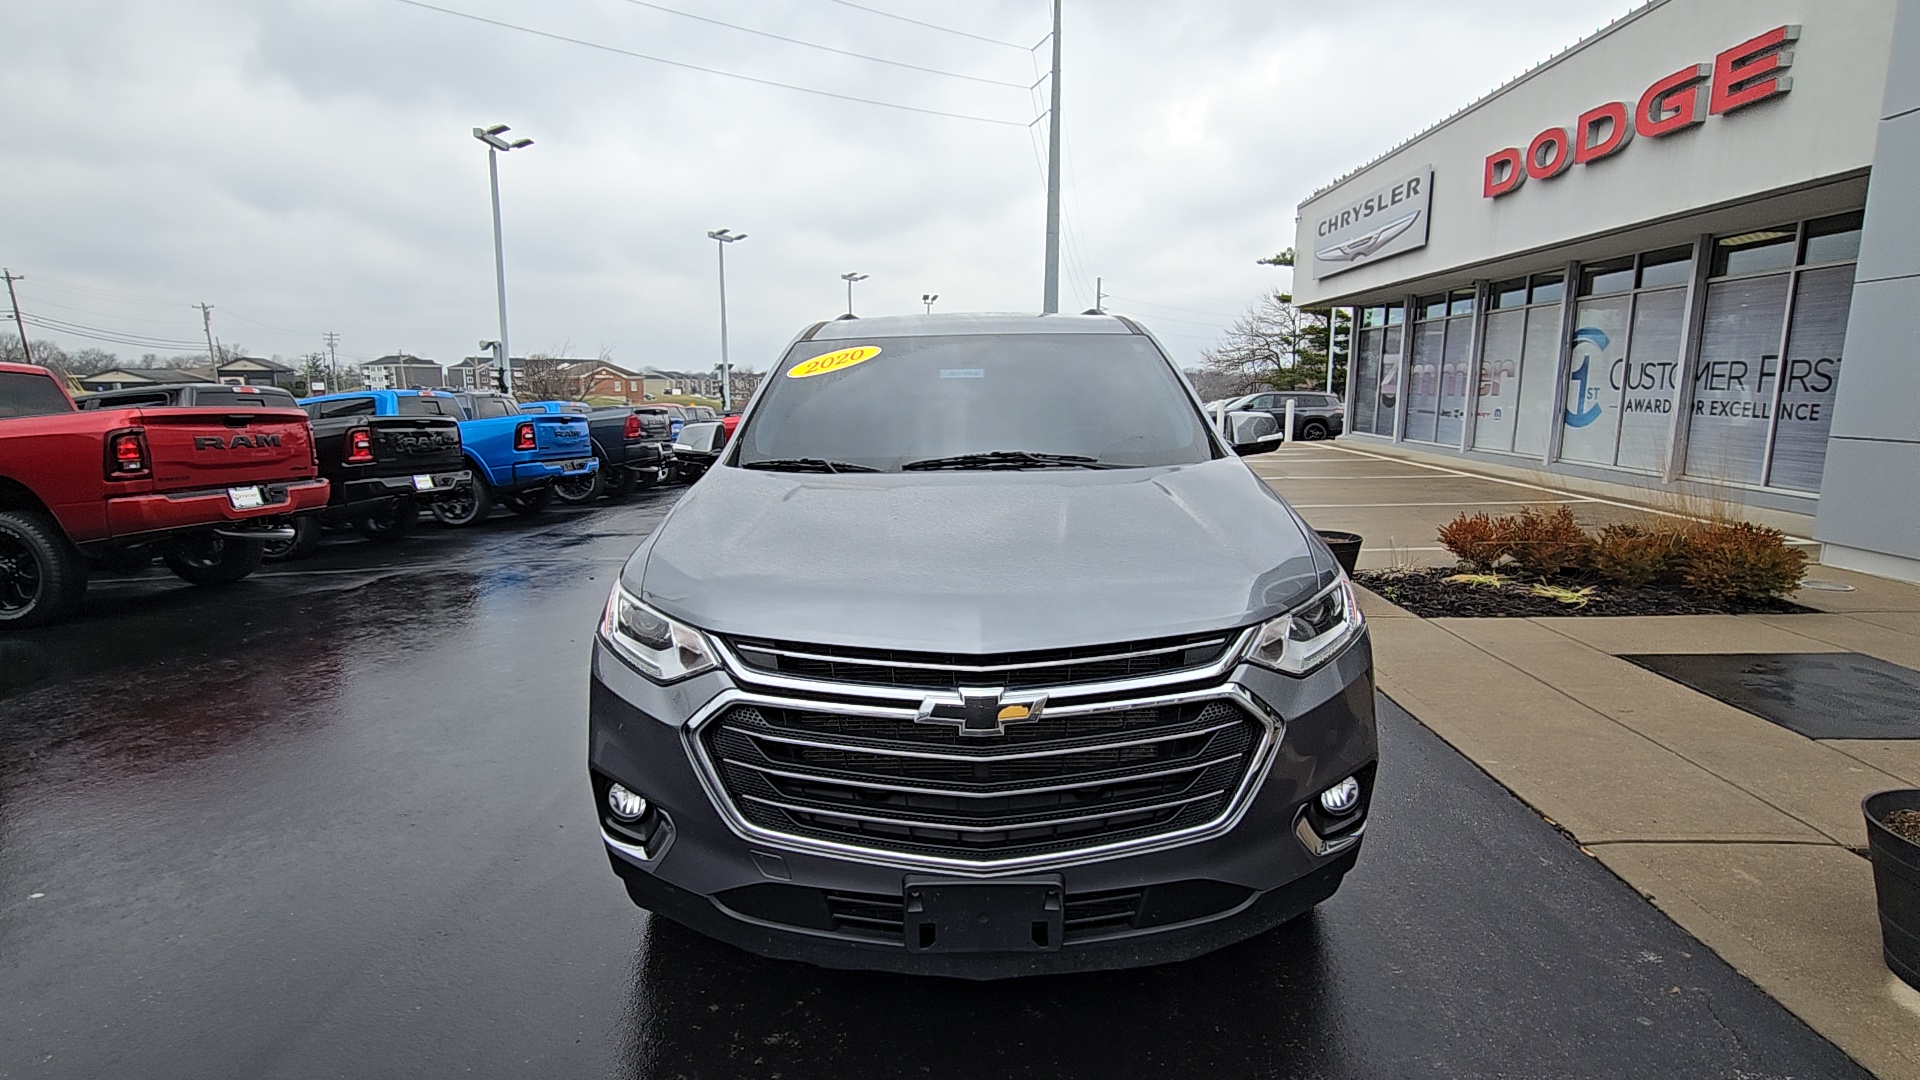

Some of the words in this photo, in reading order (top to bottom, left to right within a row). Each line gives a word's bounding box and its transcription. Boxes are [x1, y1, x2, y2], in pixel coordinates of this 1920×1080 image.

[1484, 24, 1801, 199] DODGE
[1318, 177, 1421, 237] CHRYSLER
[804, 349, 865, 375] 2020
[1381, 353, 1515, 396] Zmmer
[1757, 354, 1842, 393] FIRS
[1625, 399, 1672, 414] AWARD
[1710, 400, 1821, 421] EXCELLNCE
[193, 434, 281, 450] RAM
